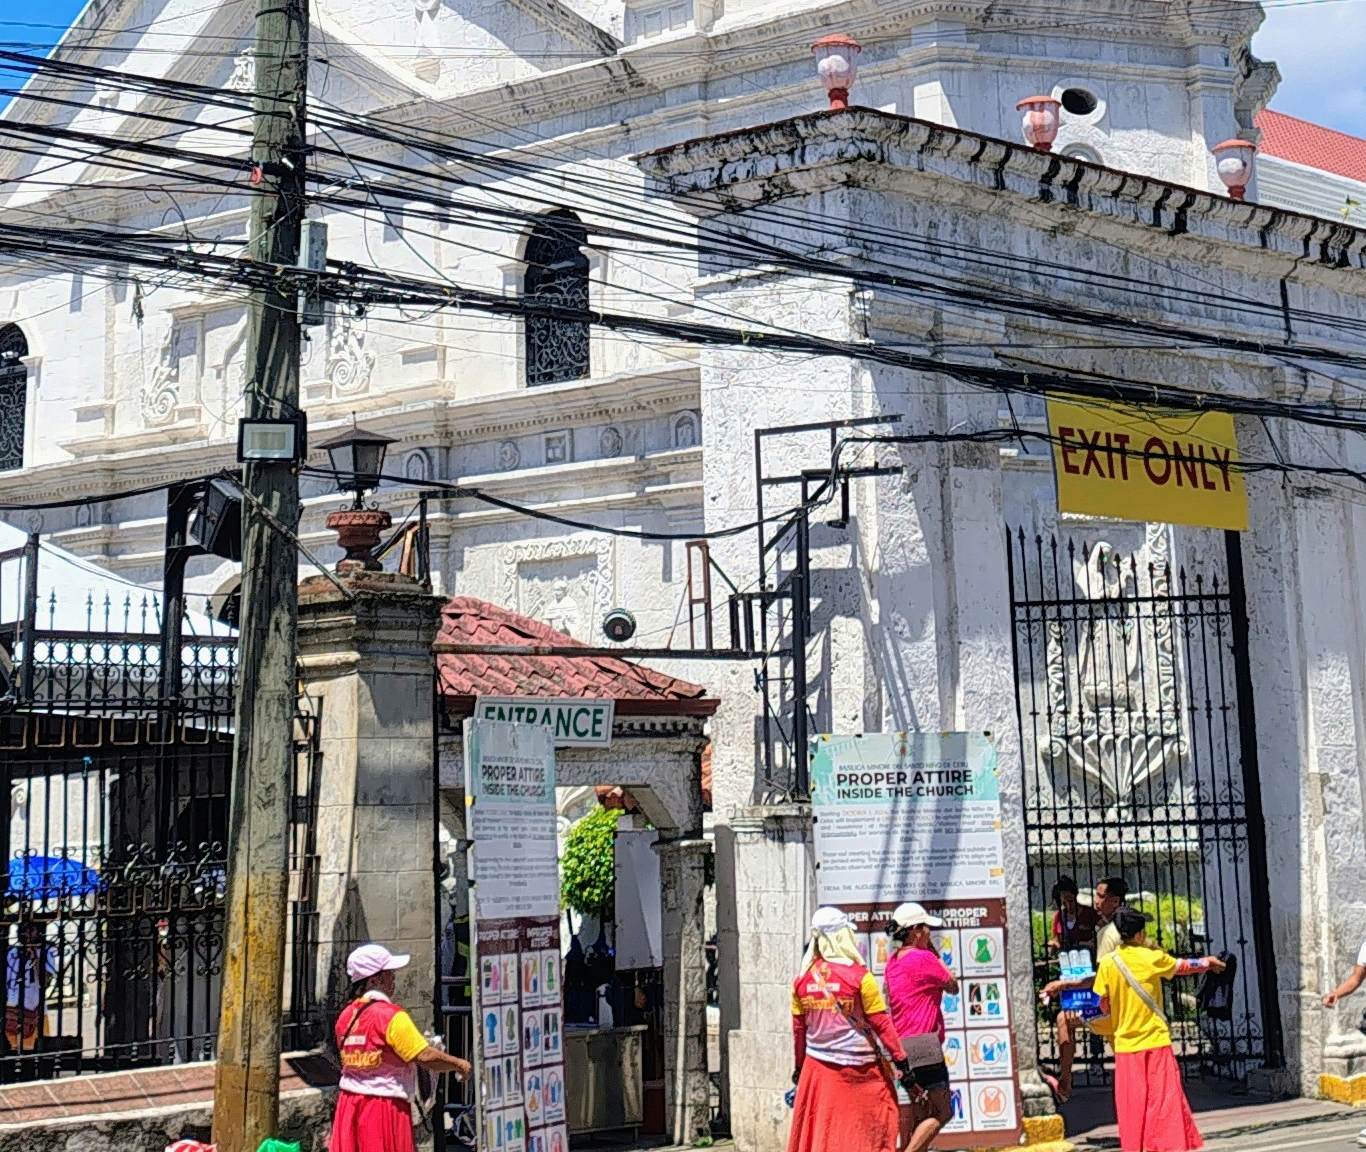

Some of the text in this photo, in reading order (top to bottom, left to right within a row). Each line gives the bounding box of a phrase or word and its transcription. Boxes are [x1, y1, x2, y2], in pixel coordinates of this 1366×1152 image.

[1058, 426, 1232, 492] EXIT ONLY
[482, 764, 545, 783] PROPER ATTIRE
[837, 769, 973, 786] PROPER ATTIRE
[507, 784, 520, 796] THE
[837, 784, 974, 799] INSIDE THE CHURCH
